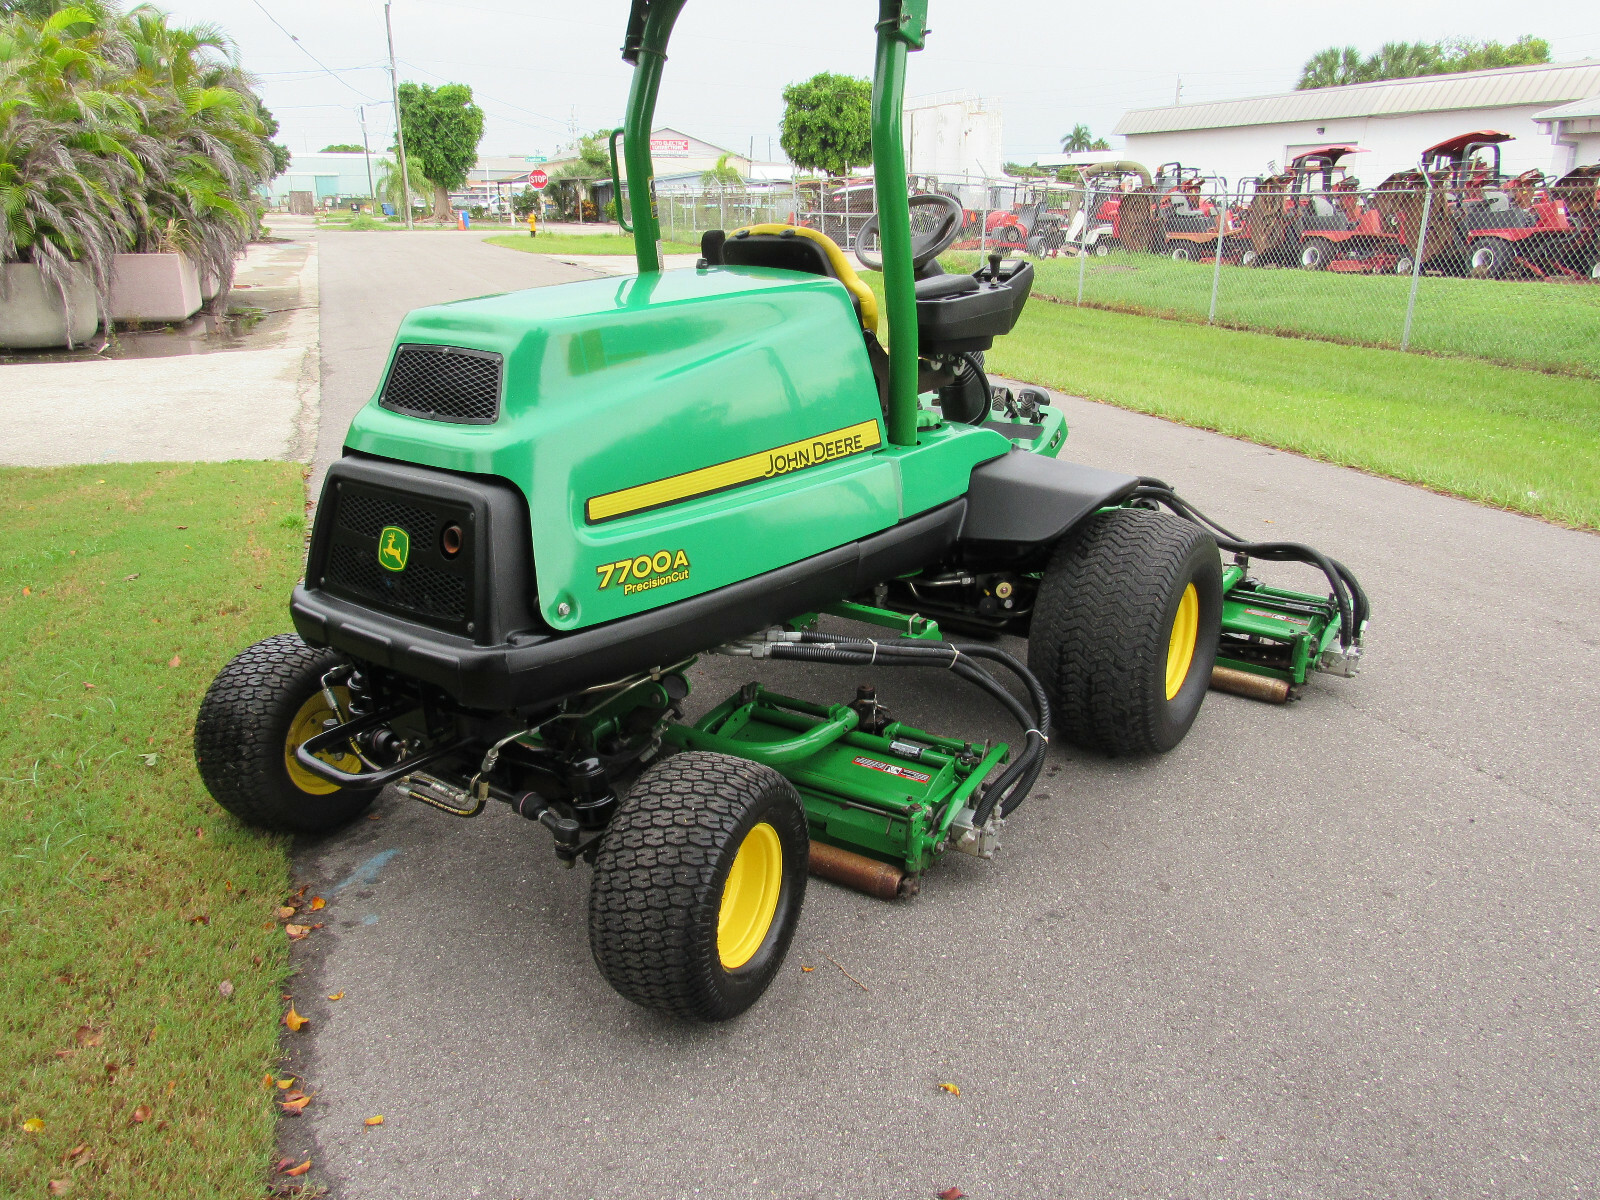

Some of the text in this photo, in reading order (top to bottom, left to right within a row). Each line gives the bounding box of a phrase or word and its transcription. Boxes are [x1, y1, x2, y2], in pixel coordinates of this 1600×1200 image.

[530, 175, 547, 184] STOP
[765, 434, 863, 475] JOHN DEERE
[597, 550, 689, 589] 7700A
[624, 569, 689, 595] PrecisionCut
